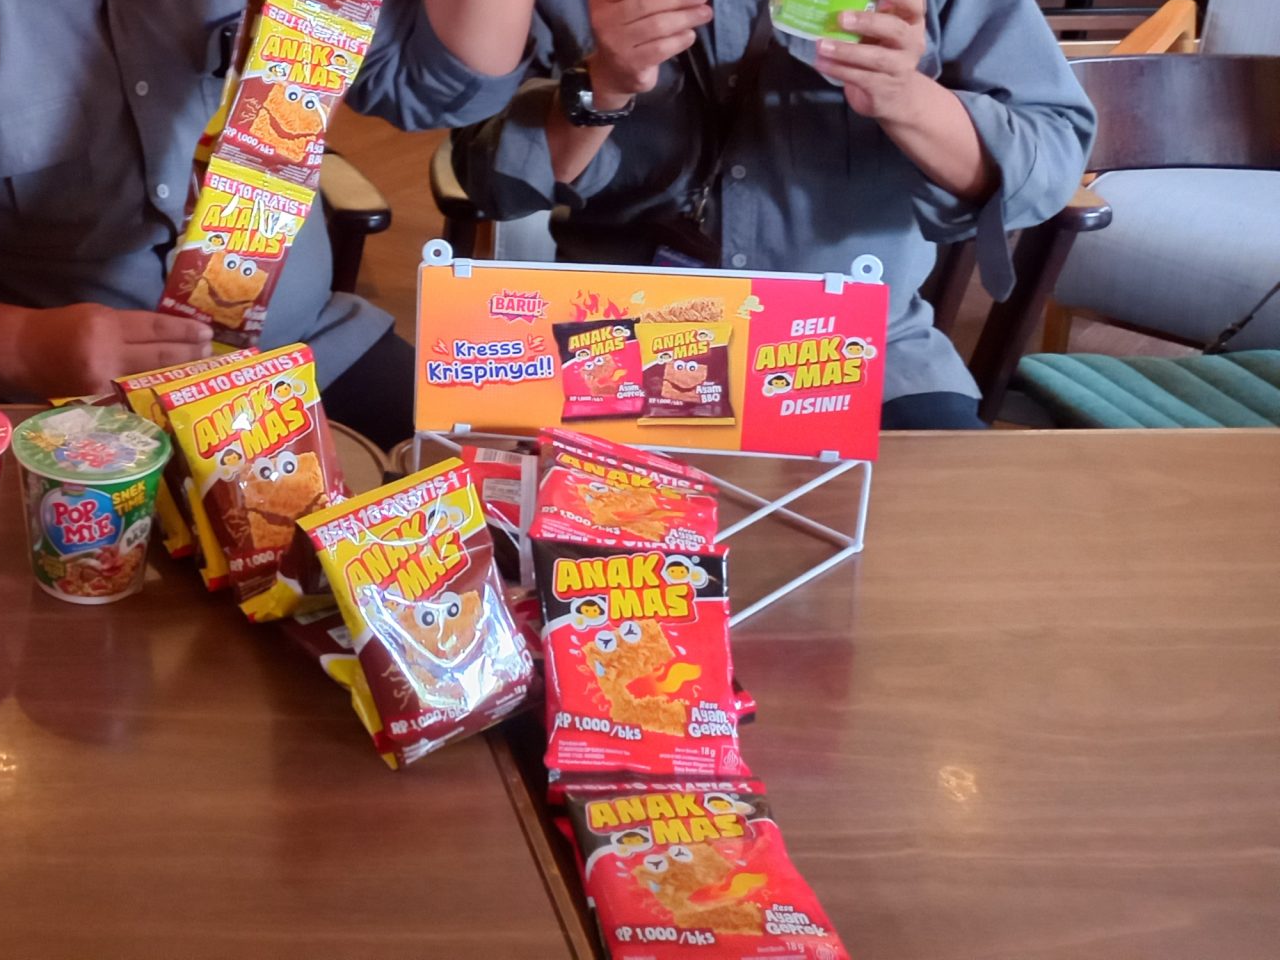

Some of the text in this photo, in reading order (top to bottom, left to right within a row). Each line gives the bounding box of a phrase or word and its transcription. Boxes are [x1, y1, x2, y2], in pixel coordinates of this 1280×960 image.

[263, 35, 333, 66] ANAK
[289, 63, 343, 90] MAS
[210, 175, 236, 194] BELI
[238, 182, 252, 197] 10
[252, 189, 298, 214] GRATIS
[229, 229, 283, 254] MAS
[495, 297, 543, 315] BARU!
[569, 326, 613, 350] ANAK
[790, 316, 836, 337] BELI
[454, 341, 524, 358] Kresss
[590, 337, 625, 357] MAS
[652, 330, 697, 351] ANAK
[673, 341, 709, 360] MAS
[755, 336, 842, 371] ANAK
[128, 374, 163, 390] BELI
[170, 350, 305, 408] BELI 10 GRATIS 1
[428, 356, 553, 385] Krispinya!!
[794, 358, 862, 390] MAS
[195, 382, 273, 454] ANAK
[779, 394, 852, 417] DISINI!
[241, 398, 306, 460] MAS
[559, 454, 653, 489] ANAK
[111, 480, 146, 505] SNEK
[51, 499, 98, 526] POP
[62, 514, 116, 545] MIE
[347, 511, 422, 596] ANAK
[396, 530, 462, 601] MAS
[556, 554, 661, 593] ANAK
[609, 585, 690, 620] MAS
[390, 720, 408, 735] RP
[691, 707, 728, 724] Ayam
[687, 723, 739, 738] Geprek
[590, 793, 705, 829] ANAK
[651, 814, 745, 846] MAS
[765, 909, 810, 925] Ayam
[765, 923, 827, 938] Geprek
